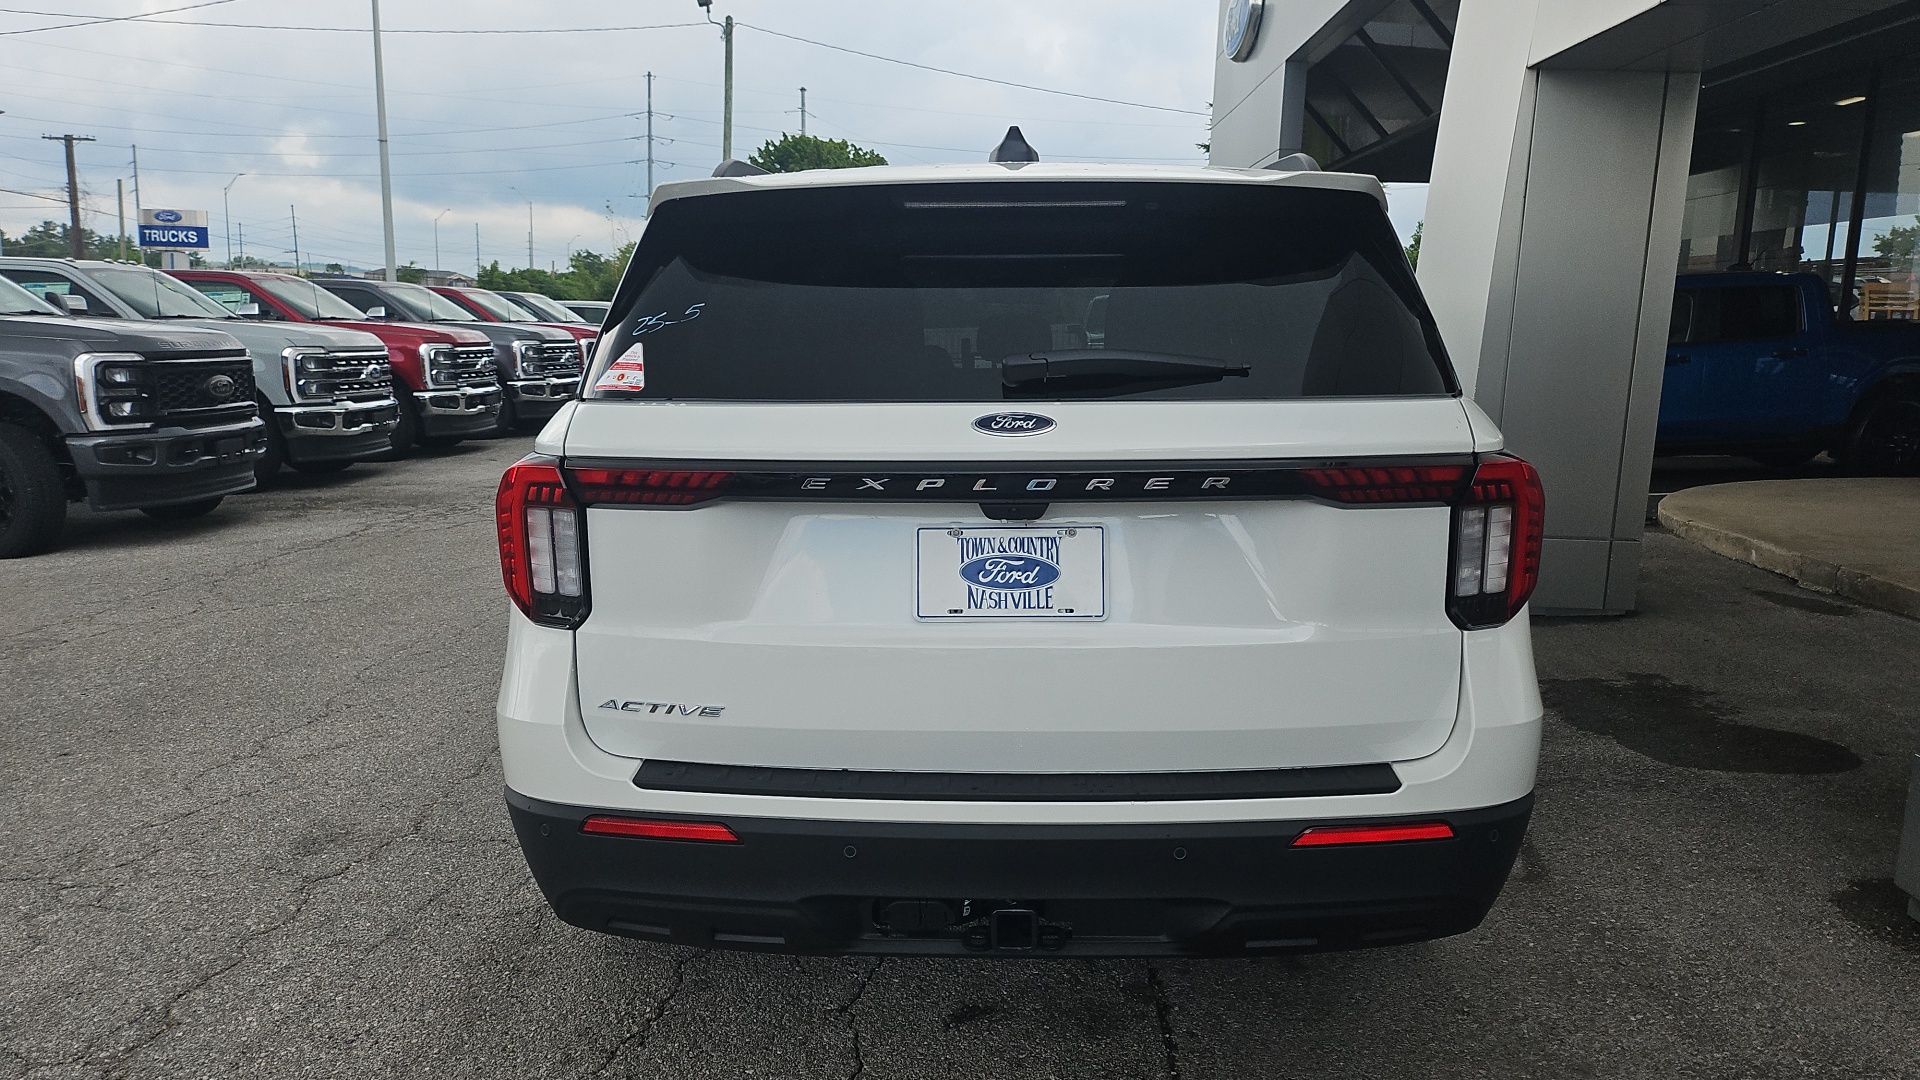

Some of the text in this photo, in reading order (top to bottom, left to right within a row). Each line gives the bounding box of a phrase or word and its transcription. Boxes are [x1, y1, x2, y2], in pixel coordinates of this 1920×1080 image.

[143, 229, 198, 243] TRUCKS
[991, 415, 1037, 429] Ford
[800, 476, 1232, 492] EXPLORER
[957, 536, 996, 564] TOWN
[1008, 536, 1062, 565] COUNTRY
[979, 558, 1041, 584] Ford
[967, 584, 1054, 610] NASHVILLE
[598, 699, 726, 718] ACTIVE
